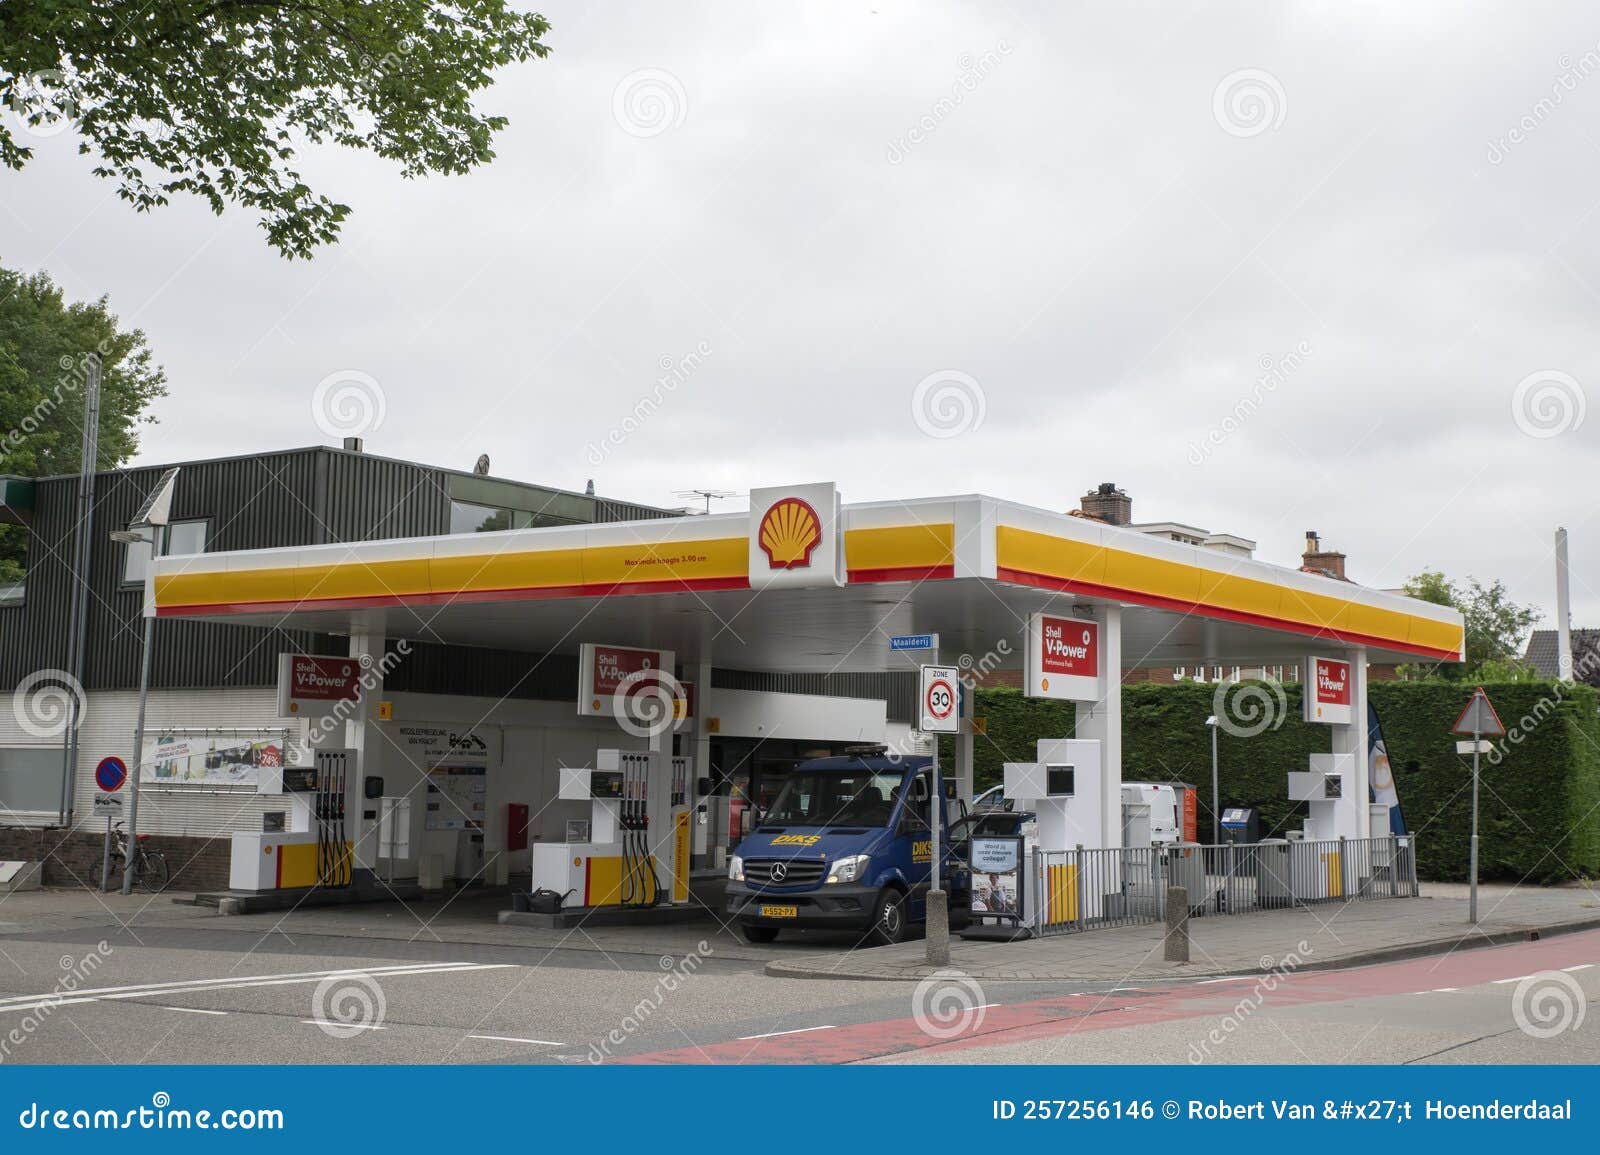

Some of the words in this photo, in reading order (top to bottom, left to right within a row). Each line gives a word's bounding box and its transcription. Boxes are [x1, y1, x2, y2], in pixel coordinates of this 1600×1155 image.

[1045, 625, 1062, 638] Shell
[893, 637, 929, 647] Maalderij
[599, 654, 617, 665] Shell
[296, 663, 316, 673] Shell
[1318, 665, 1329, 676] Shell
[933, 670, 948, 678] ZONE
[932, 692, 949, 707] 30
[771, 834, 822, 844] DIKS
